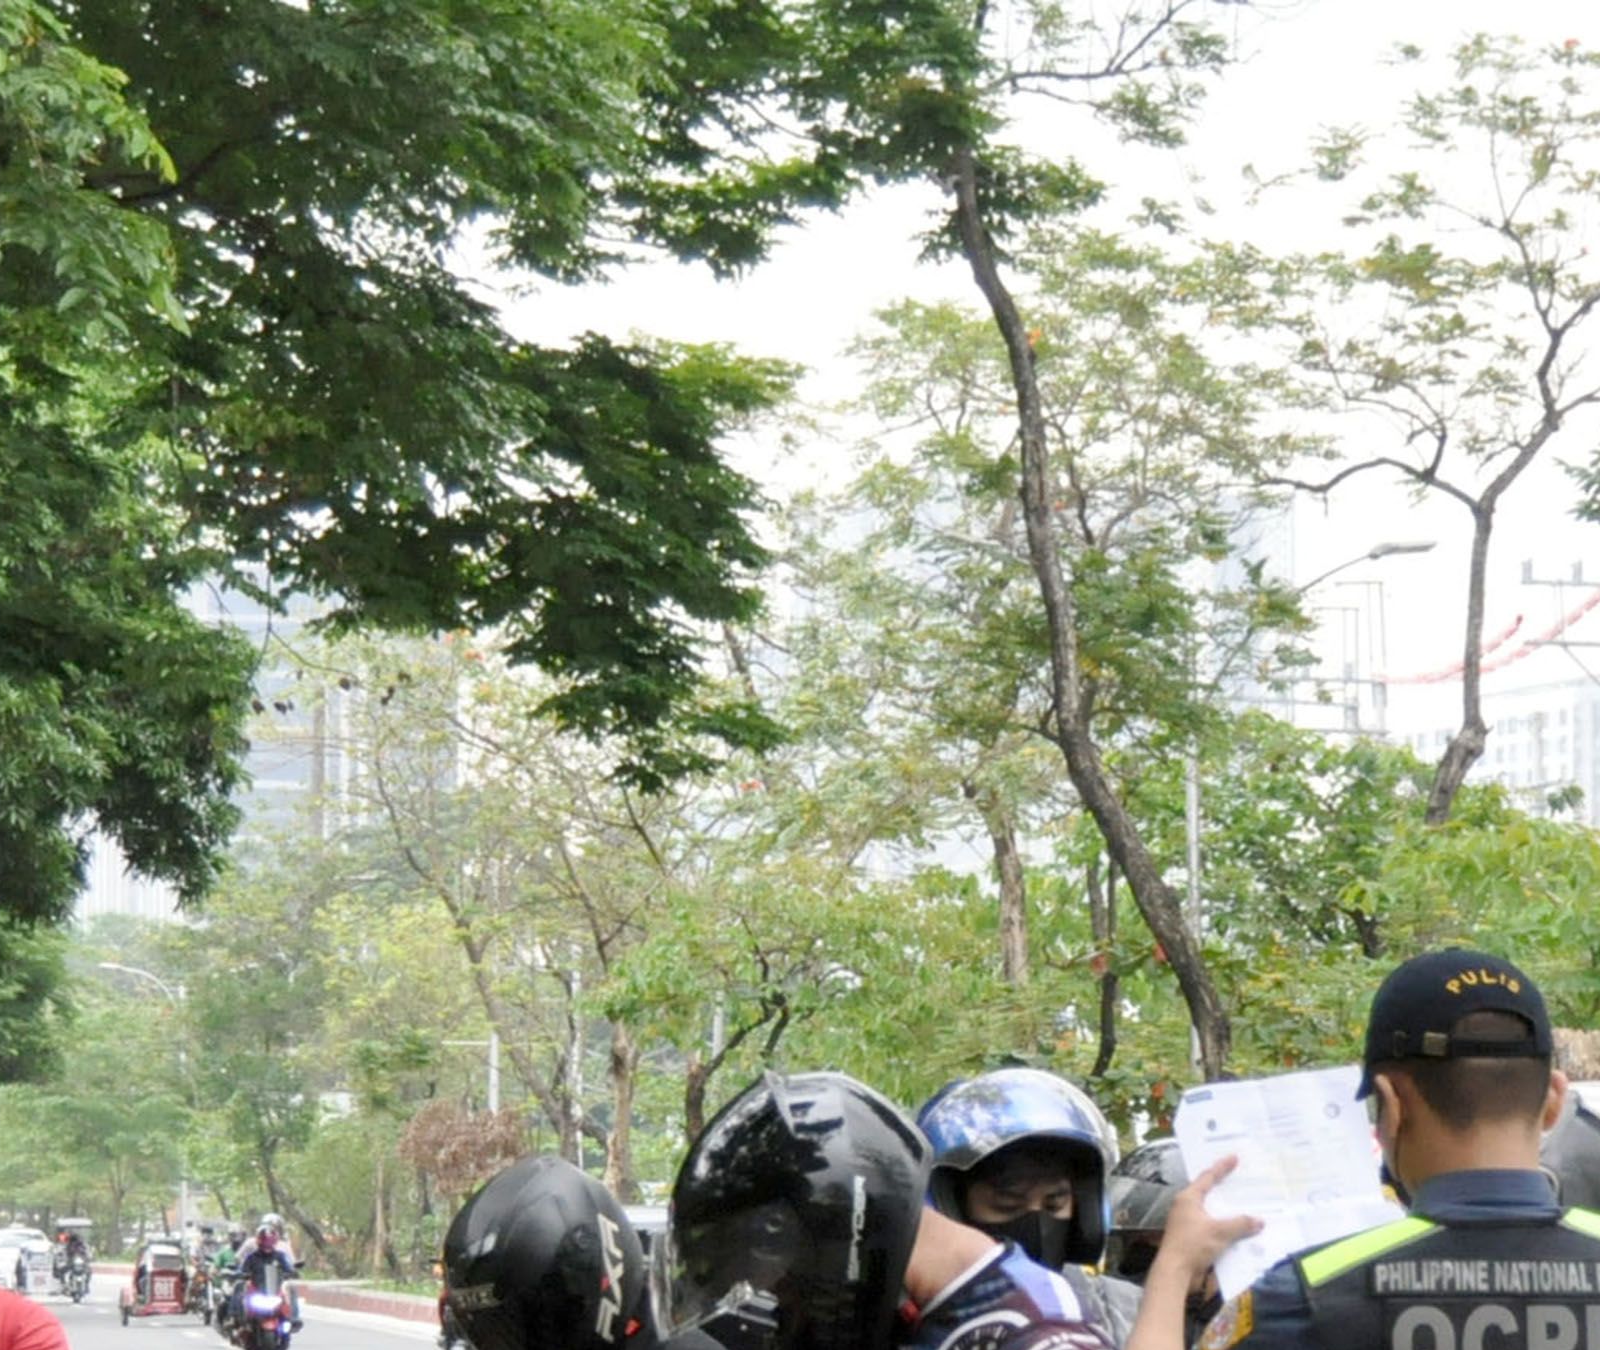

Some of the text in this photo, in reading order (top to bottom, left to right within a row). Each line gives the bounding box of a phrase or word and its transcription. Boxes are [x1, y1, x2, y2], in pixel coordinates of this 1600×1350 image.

[1445, 968, 1521, 994] PULIS
[1375, 1260, 1490, 1293] PHILIPPINE
[1493, 1261, 1593, 1294] NATIONAL
